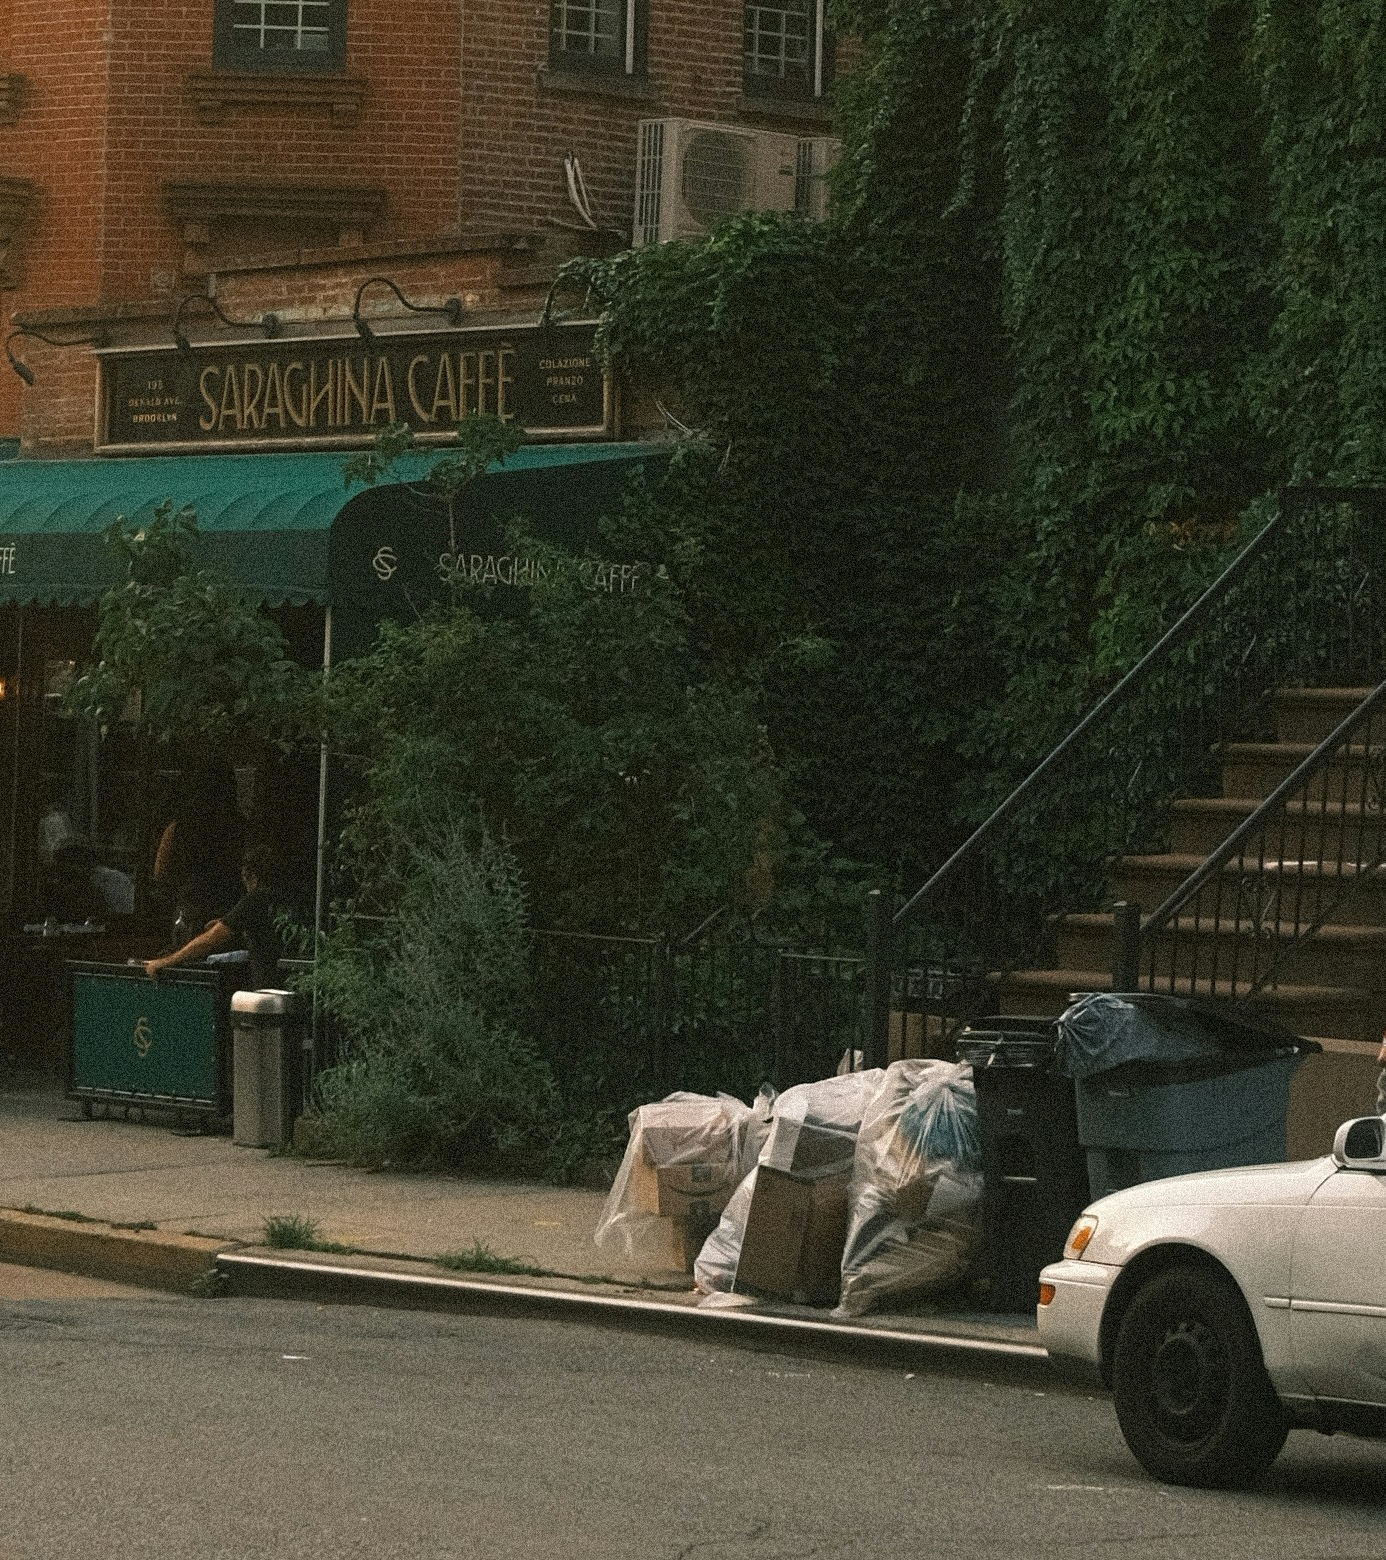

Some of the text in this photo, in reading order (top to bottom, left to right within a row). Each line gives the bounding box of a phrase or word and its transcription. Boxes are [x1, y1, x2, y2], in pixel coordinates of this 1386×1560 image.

[539, 357, 591, 369] COLAZIONE
[198, 341, 515, 431] SARAGHINA CAFFÈ
[546, 375, 584, 386] PRANZO
[132, 412, 178, 423] BROOKLYN
[438, 553, 566, 586] SARAGHIN
